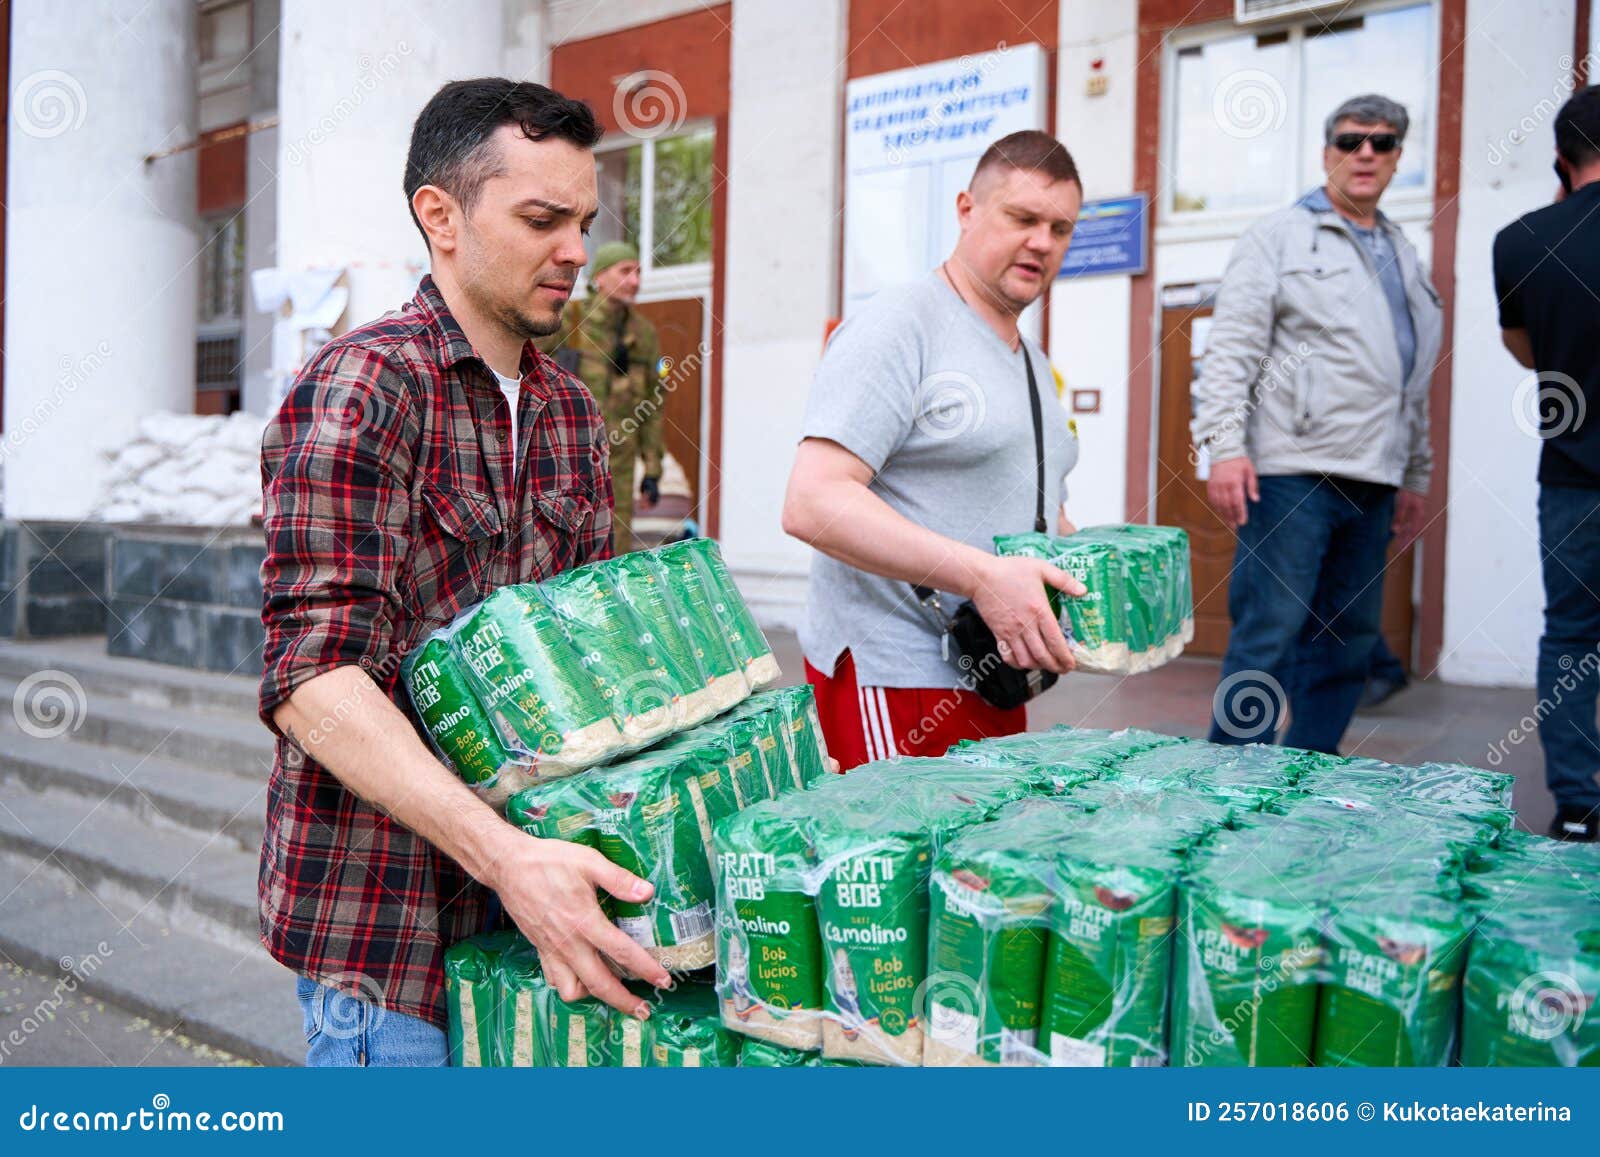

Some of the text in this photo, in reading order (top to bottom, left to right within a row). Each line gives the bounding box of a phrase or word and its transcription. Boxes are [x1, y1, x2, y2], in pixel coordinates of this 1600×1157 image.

[456, 729, 476, 749] Bob
[460, 737, 490, 765] Lucios
[825, 921, 908, 945] Camolino
[762, 946, 787, 961] Bob
[758, 964, 798, 979] Lucios
[874, 955, 903, 975] Bob
[870, 976, 914, 993] Lucios
